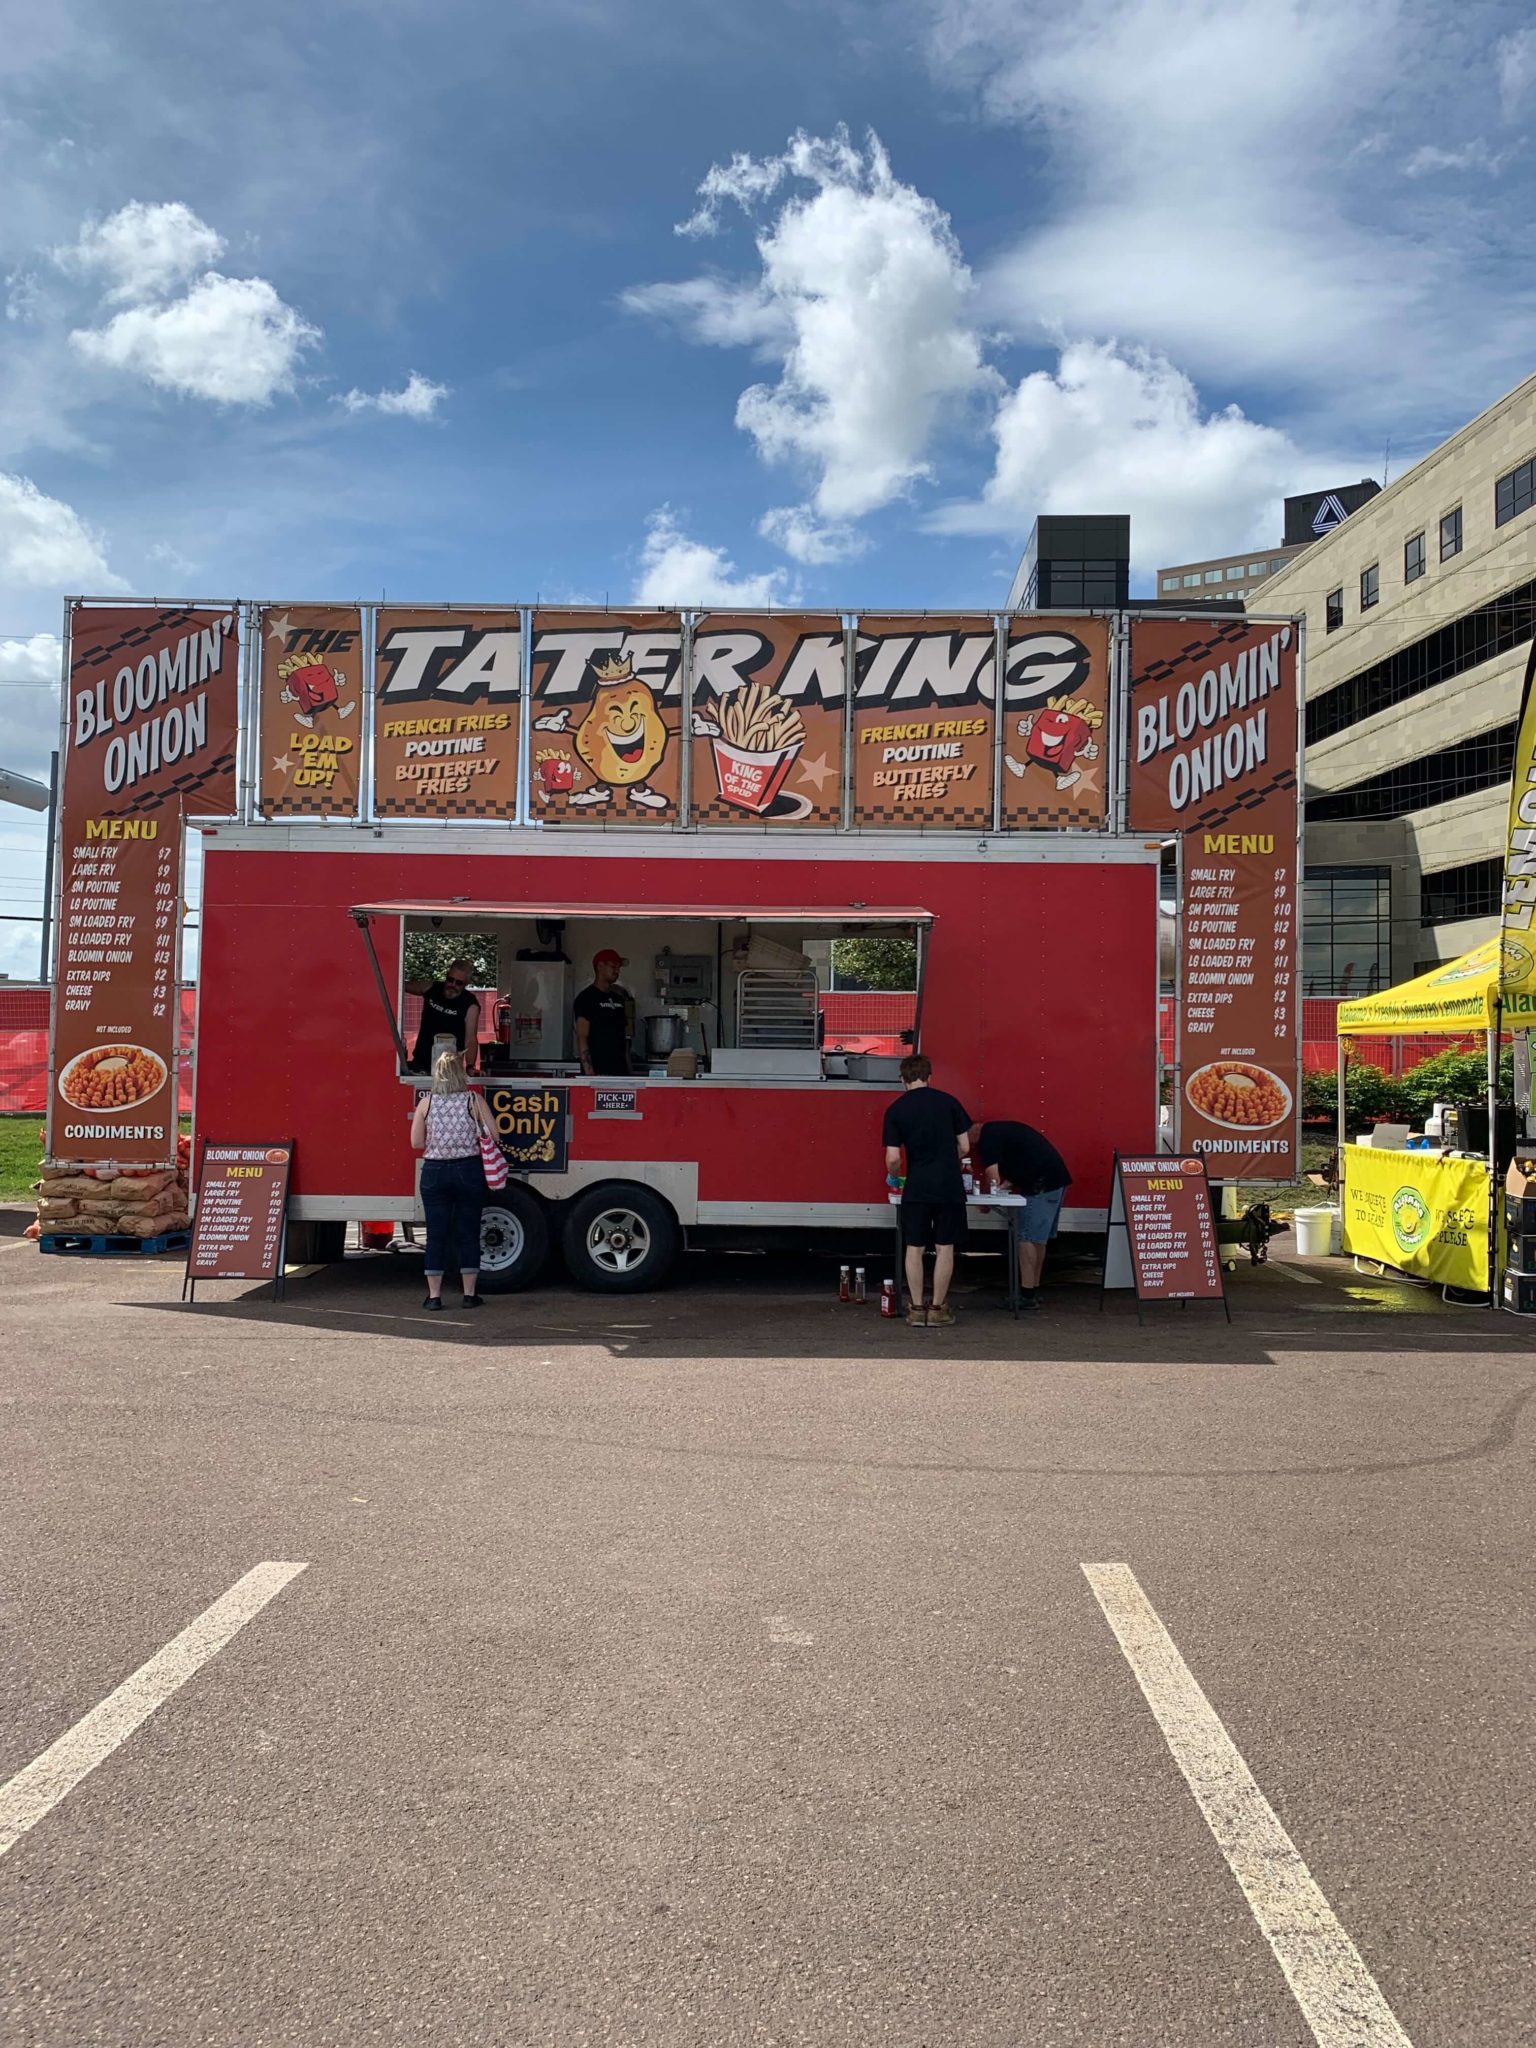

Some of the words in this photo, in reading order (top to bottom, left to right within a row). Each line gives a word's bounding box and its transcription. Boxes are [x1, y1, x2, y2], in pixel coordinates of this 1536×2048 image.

[283, 629, 360, 653] THE
[384, 629, 764, 698] TATER
[778, 634, 1077, 701] KING
[75, 614, 233, 747] BLOOMIN'
[1137, 627, 1291, 765] BLOOMIN'
[383, 718, 454, 738] FRENCH
[456, 714, 510, 732] FRIES
[861, 723, 930, 744] FRENCH
[933, 719, 986, 738] FRIES
[104, 692, 207, 794] ONION
[290, 733, 353, 753] LOAD
[405, 737, 485, 758] POUTINE
[882, 742, 962, 763] POUTINE
[1168, 708, 1267, 811] ONION
[396, 759, 498, 780] BUTTERFLY
[731, 760, 763, 782] KING
[873, 764, 976, 786] BUTTERFLY
[293, 769, 334, 789] UP!
[417, 776, 470, 795] FRIES
[724, 773, 739, 785] OF
[741, 778, 761, 793] THE
[727, 785, 752, 798] SPUD
[894, 782, 947, 801] FRIES
[86, 819, 158, 839] MENU
[1204, 834, 1274, 854] MENU
[72, 847, 98, 859] SMALL
[100, 847, 118, 859] FRY
[158, 847, 171, 860] $7
[72, 864, 98, 876] LARGE
[99, 864, 116, 876] FRY
[157, 864, 170, 878] $9
[1190, 868, 1216, 881] SMALL
[1219, 869, 1236, 881] FRY
[1274, 868, 1286, 882] $7
[71, 881, 83, 893] SM
[85, 881, 121, 893] POUTINE
[154, 882, 171, 895] $10
[1189, 886, 1217, 898] LARGE
[1217, 886, 1235, 898] FRY
[1274, 886, 1286, 899] $9
[70, 898, 80, 911] LG
[82, 898, 117, 911] POUTINE
[156, 900, 174, 912] $12
[1188, 903, 1202, 916] SM
[1203, 903, 1240, 916] POUTINE
[1274, 903, 1291, 916] $10
[69, 915, 82, 928] SM
[83, 915, 116, 928] LOADED
[117, 916, 136, 928] FRY
[155, 916, 168, 929] $9
[1188, 921, 1199, 932] LG
[1201, 921, 1237, 933] POUTINE
[1274, 920, 1289, 933] $12
[68, 932, 79, 945] LG
[80, 932, 113, 945] LOADED
[114, 933, 132, 946] FRY
[156, 934, 171, 947] $11
[1188, 938, 1202, 950] SM
[1203, 938, 1236, 950] LOADED
[1238, 938, 1255, 951] FRY
[1274, 938, 1286, 951] $9
[68, 950, 105, 962] BLOOMIN
[106, 951, 133, 963] ONION
[154, 950, 170, 964] $13
[1188, 955, 1200, 967] LG
[1201, 955, 1234, 968] LOADED
[1235, 956, 1253, 968] FRY
[1274, 955, 1288, 968] $11
[66, 970, 91, 981] EXTRA
[92, 971, 111, 982] DIPS
[154, 968, 167, 981] $2
[1188, 972, 1226, 985] BLOOMIN
[1228, 973, 1254, 985] ONION
[1274, 972, 1290, 985] $13
[66, 985, 93, 996] CHEESE
[153, 985, 166, 999] $3
[1187, 993, 1213, 1003] EXTRA
[1215, 993, 1233, 1004] DIPS
[1274, 990, 1286, 1003] $2
[65, 1000, 91, 1011] GRAVY
[153, 1003, 166, 1016] $2
[1439, 992, 1484, 1017] Lemonade
[1188, 1007, 1215, 1018] CHEESE
[1274, 1007, 1286, 1020] $3
[1188, 1022, 1214, 1033] GRAVY
[1274, 1024, 1286, 1037] $2
[493, 1091, 559, 1113] Cash
[597, 1094, 634, 1102] PICK-UP
[64, 1125, 164, 1139] CONDIMENTS
[495, 1112, 556, 1139] Only
[1192, 1139, 1289, 1154] CONDIMENTS
[207, 1150, 241, 1161] BLOOMIN'
[242, 1151, 265, 1161] ONION
[226, 1167, 263, 1178] MENU
[1122, 1162, 1157, 1172] BLOOMIN'
[1158, 1162, 1180, 1172] ONION
[1147, 1179, 1184, 1191] MENU
[1153, 1194, 1166, 1202] FRY
[212, 1207, 240, 1215] POUTINE
[1132, 1204, 1152, 1212] LARGE
[238, 1216, 253, 1224] FRY
[1145, 1213, 1173, 1221] POUTINE
[1135, 1223, 1143, 1231] LG
[1147, 1232, 1173, 1240] LOADED
[1173, 1241, 1187, 1249] FRY
